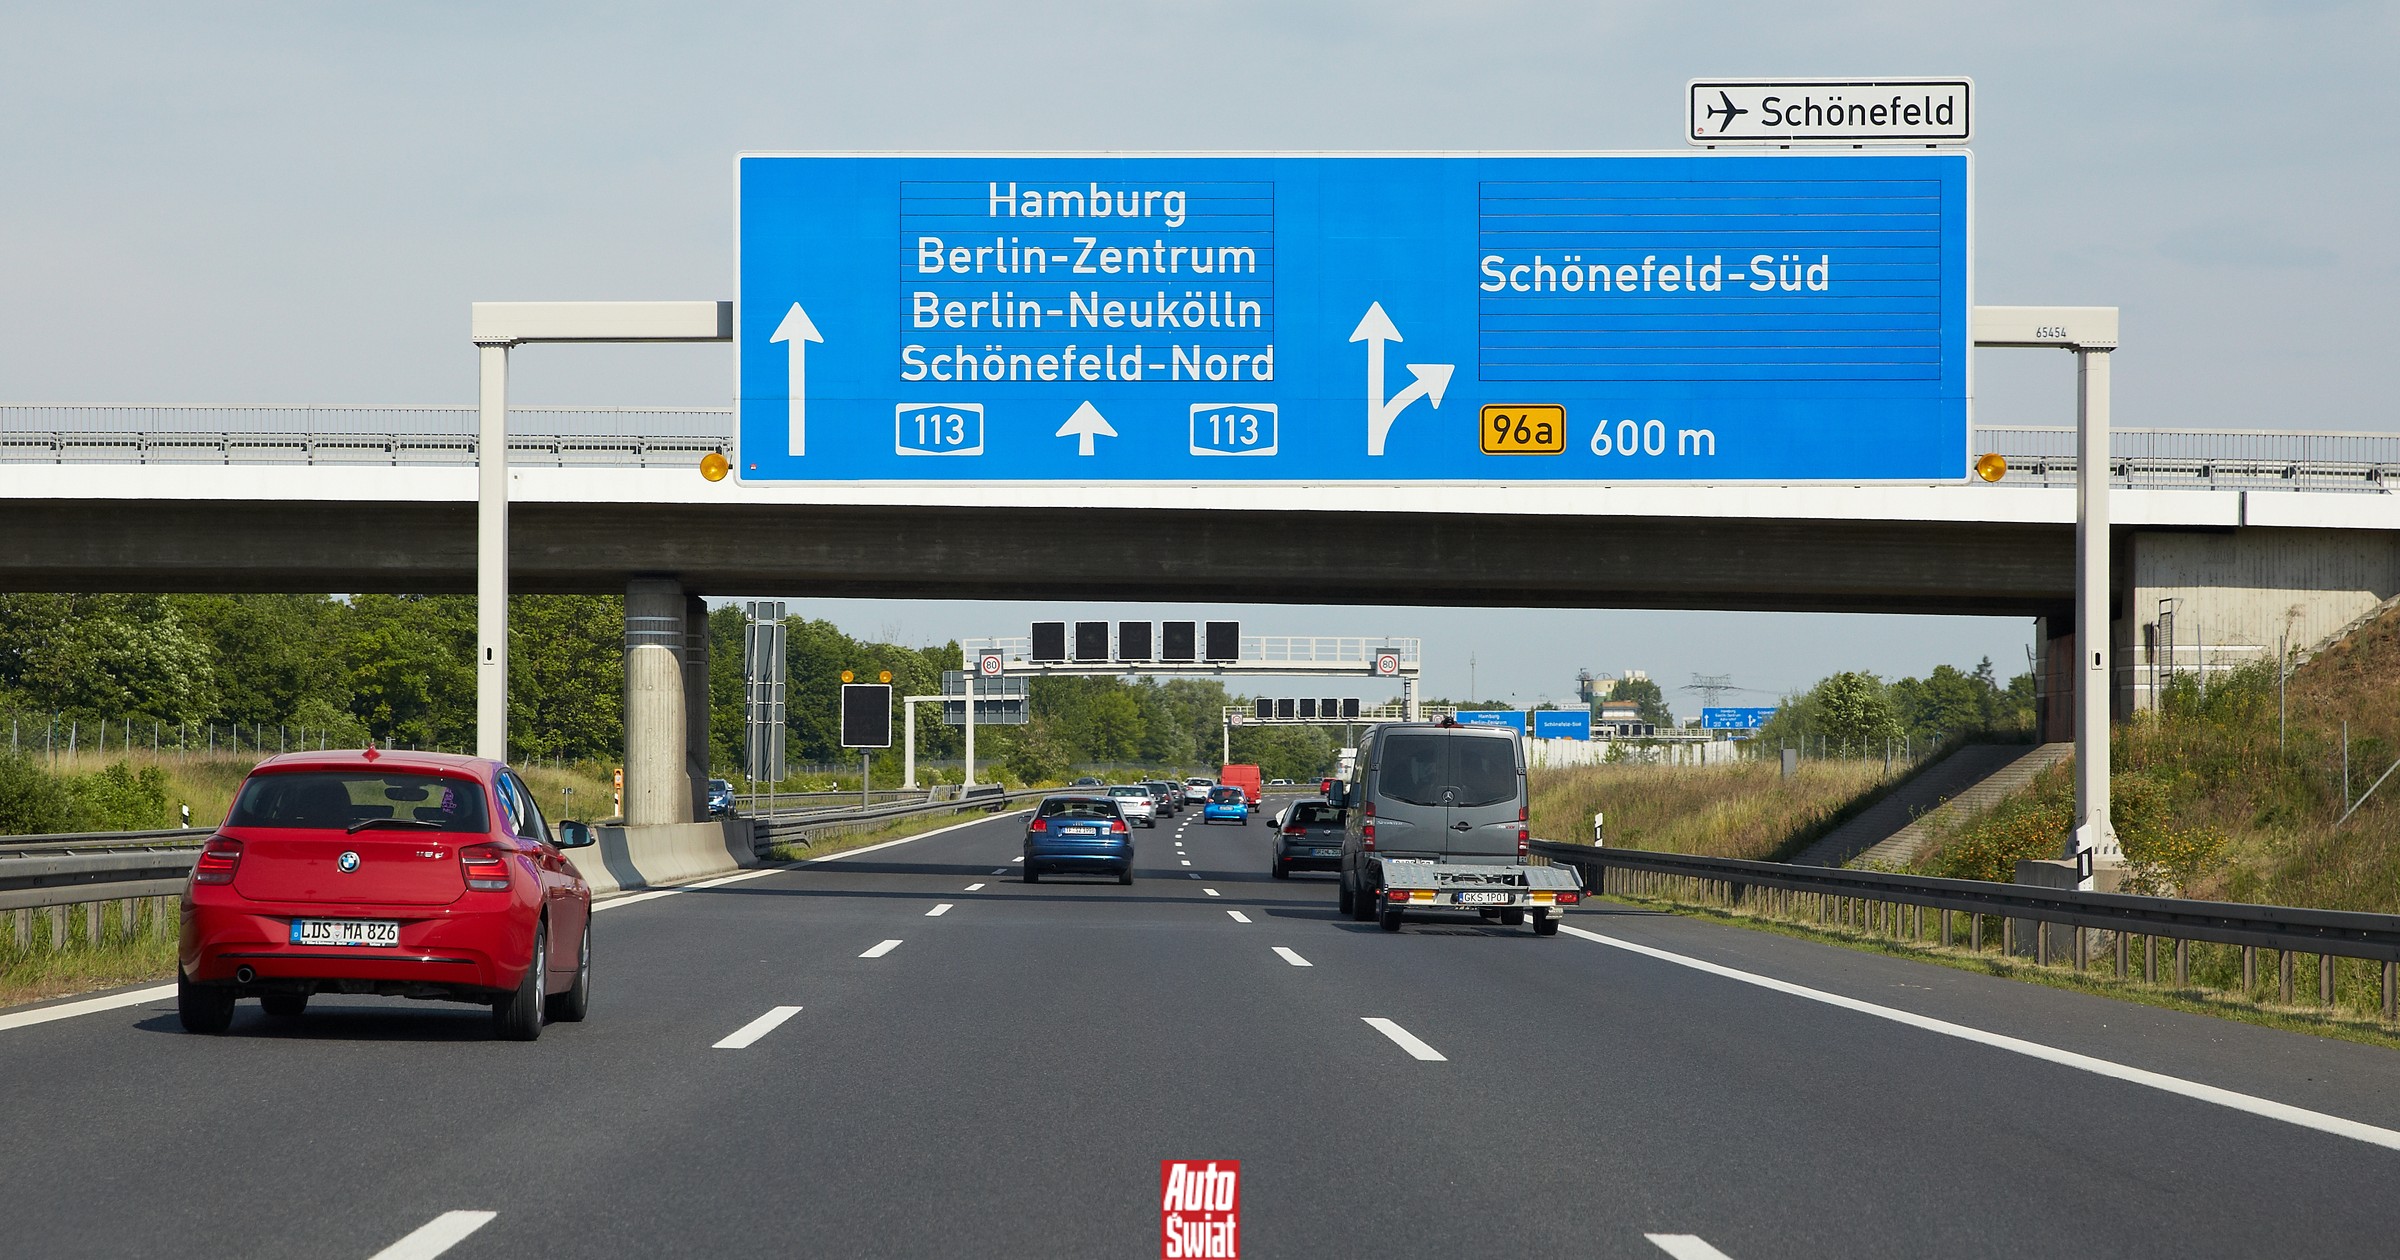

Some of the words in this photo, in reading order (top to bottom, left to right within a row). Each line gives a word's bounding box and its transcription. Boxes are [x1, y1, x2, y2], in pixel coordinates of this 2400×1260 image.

[1761, 96, 1954, 127] Schönefeld
[989, 182, 1186, 228] Hamburg
[918, 236, 1256, 274] Berlin-Zentrum
[1479, 254, 1830, 293] Schönefeld-Süd
[912, 291, 1262, 328] Berlin-Neukölln
[2036, 327, 2067, 339] 65454
[901, 344, 1275, 381] Schönefeld-Nord
[914, 414, 965, 445] 113
[1208, 414, 1259, 445] 113
[1493, 414, 1553, 445] 96a
[1590, 419, 1666, 456] 600
[1678, 429, 1716, 456] m
[986, 660, 997, 670] 80
[1382, 660, 1393, 669] 80
[1464, 893, 1484, 902] GKS
[1486, 893, 1507, 902] 1P01
[301, 922, 331, 939] LDS
[343, 923, 363, 940] MA
[367, 924, 396, 941] 826
